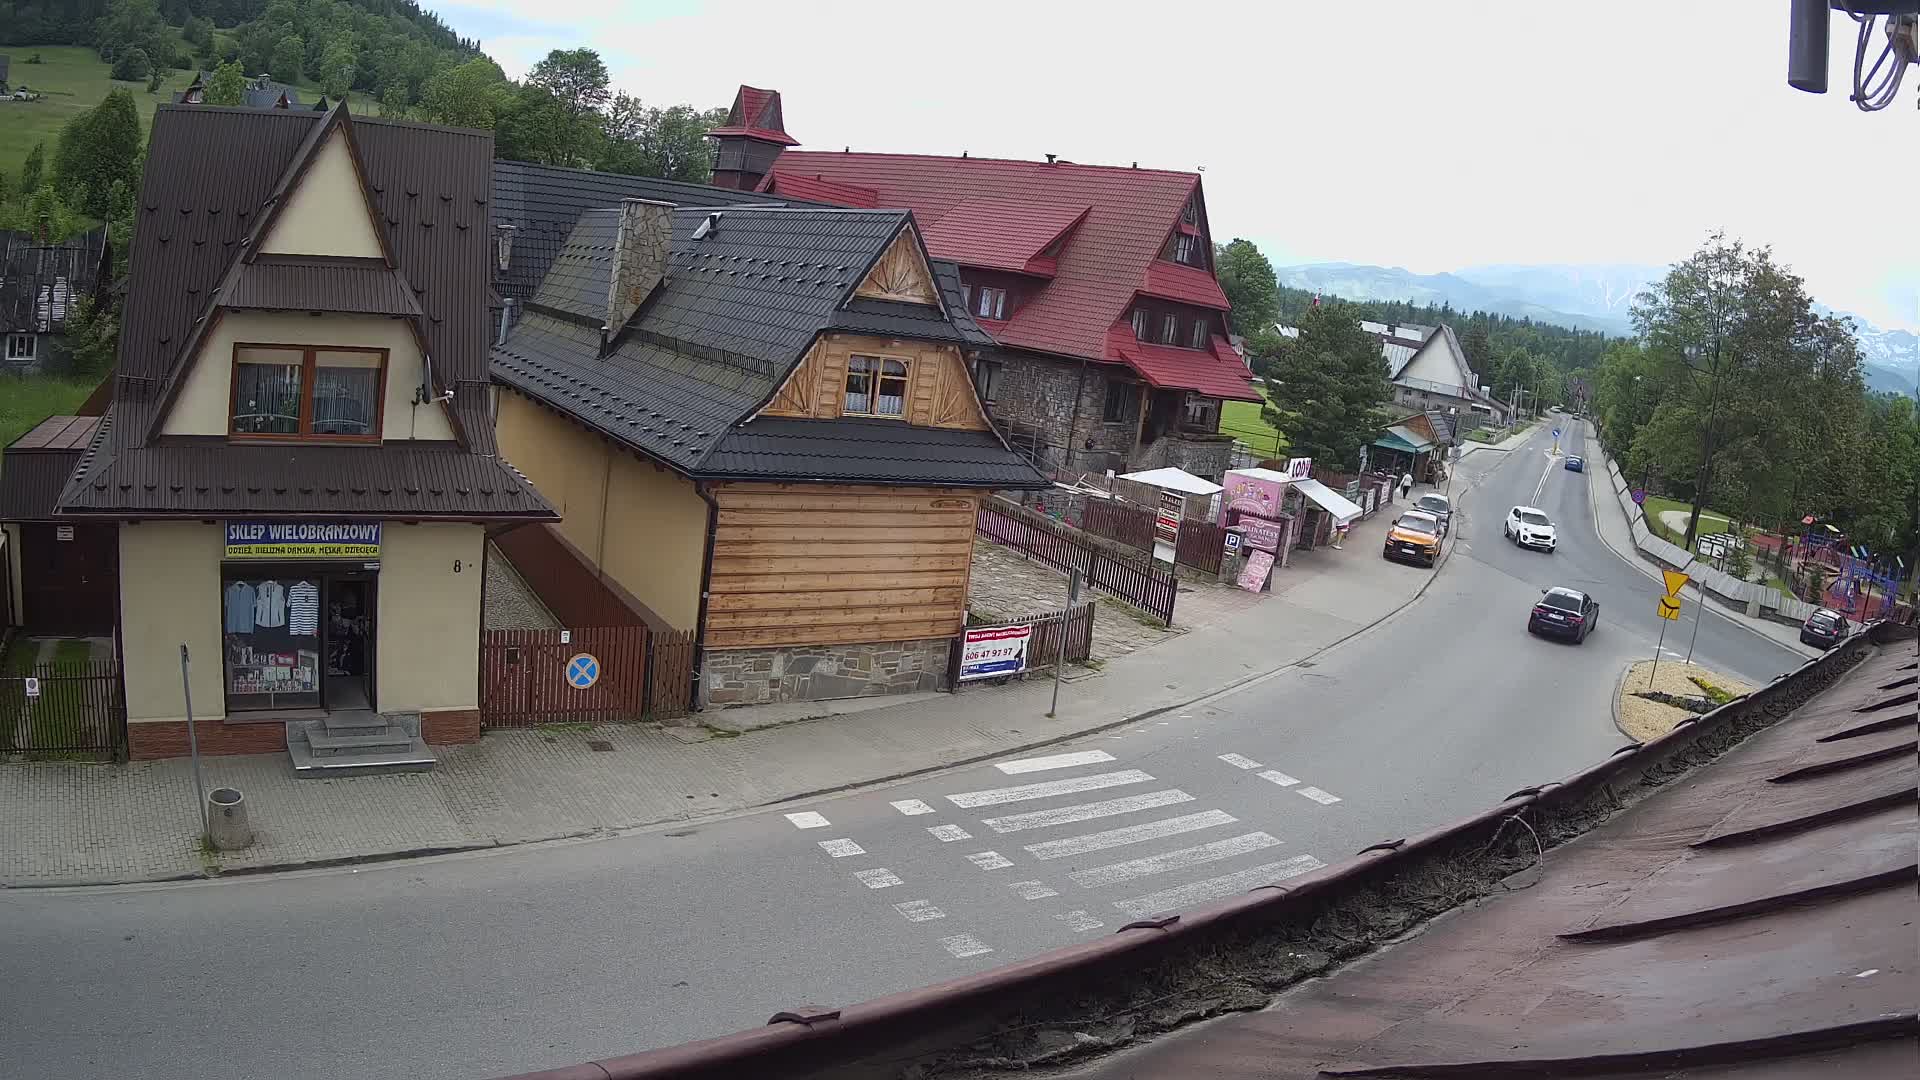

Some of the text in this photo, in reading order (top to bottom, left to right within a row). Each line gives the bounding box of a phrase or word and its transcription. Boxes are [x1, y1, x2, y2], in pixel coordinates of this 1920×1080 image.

[229, 524, 266, 540] SKLEP
[1229, 536, 1237, 545] P
[453, 559, 461, 573] 8
[965, 647, 1013, 661] 606 47 97 97
